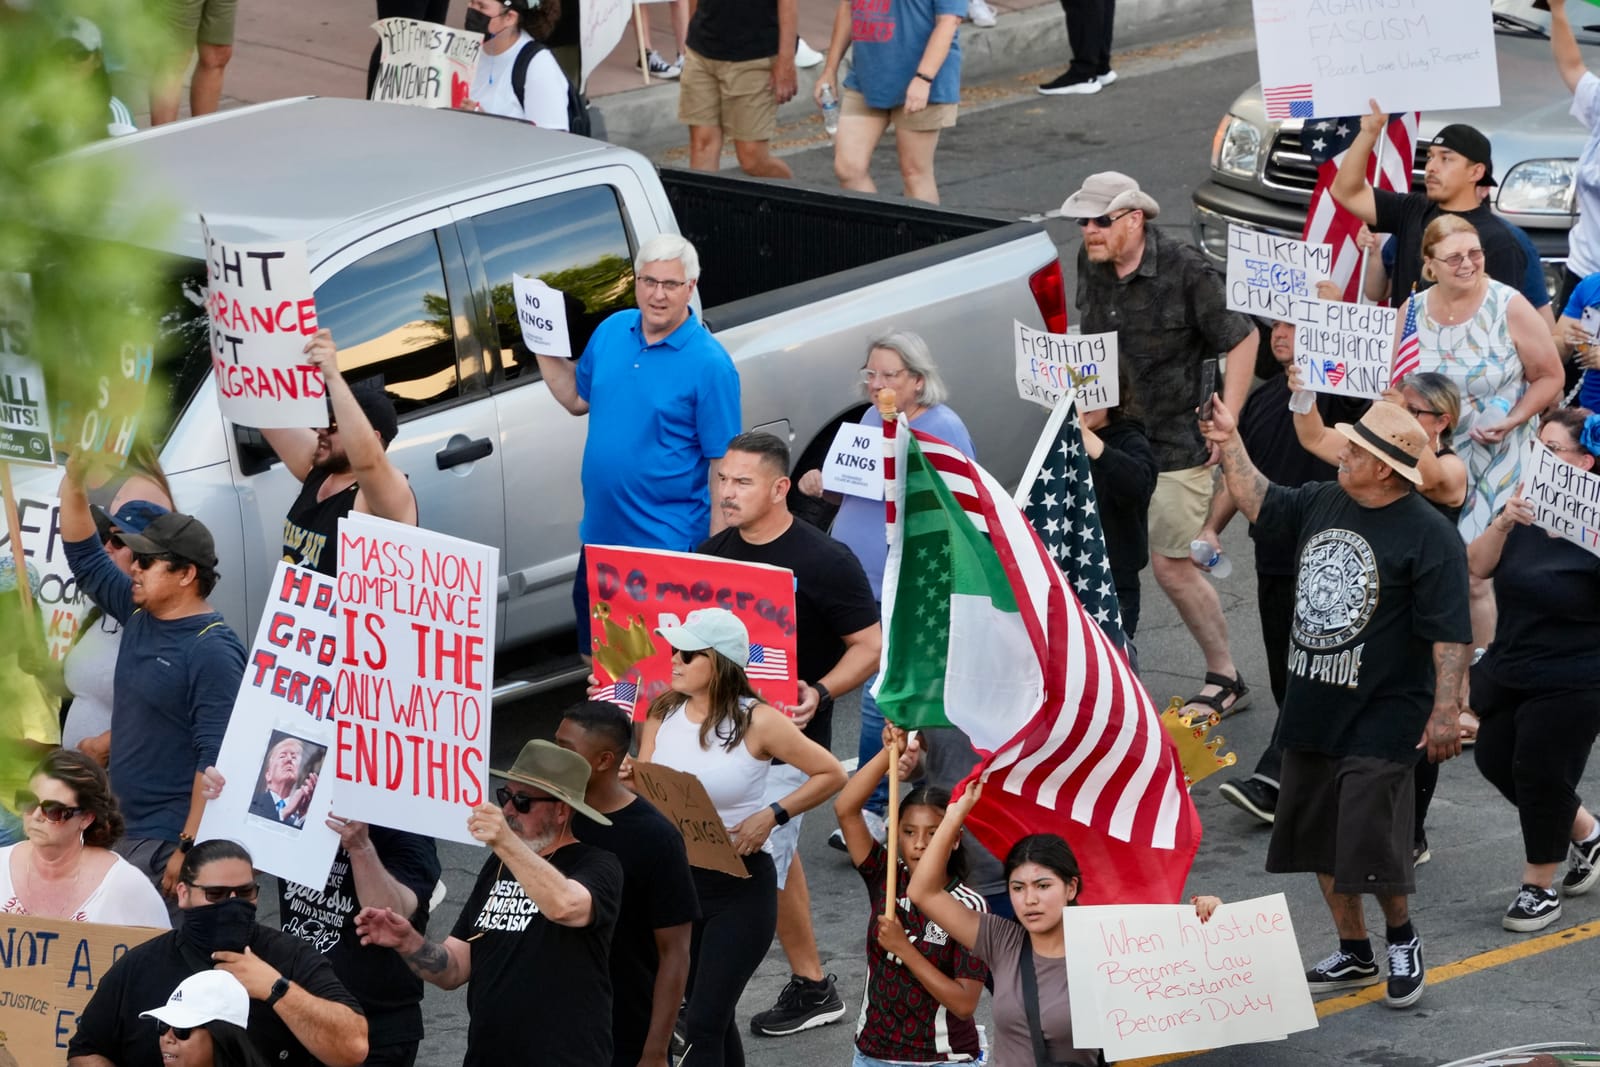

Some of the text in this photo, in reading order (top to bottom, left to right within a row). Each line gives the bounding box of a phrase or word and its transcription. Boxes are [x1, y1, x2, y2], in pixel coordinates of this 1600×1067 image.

[1308, 14, 1431, 48] FASCISM
[1360, 53, 1395, 74] Love
[1230, 229, 1251, 253] I
[205, 236, 285, 291] GHT
[1245, 259, 1308, 297] ICE
[209, 290, 319, 336] RANCE
[525, 293, 540, 309] NO
[1298, 300, 1320, 323] I
[520, 309, 553, 331] KINGS
[212, 331, 244, 364] OT
[1021, 327, 1106, 363] Fighting
[1300, 326, 1388, 364] allegiance
[212, 360, 326, 401] IGRANTS
[1030, 358, 1099, 389] fascim
[1297, 353, 1308, 364] to
[1346, 366, 1389, 393] KING
[1074, 385, 1107, 406] 941
[852, 436, 870, 449] NO
[836, 453, 876, 471] KINGS
[341, 532, 481, 594] MASS NON
[280, 567, 336, 618] HO
[338, 572, 481, 628] COMPLIANCE
[342, 609, 483, 690] IS THE
[1310, 643, 1365, 688] PRIDE
[335, 669, 480, 741] ONLY WAY TO
[336, 721, 482, 807] END THIS
[319, 908, 345, 928] CACTUS
[1100, 912, 1286, 957] When Injustice
[0, 928, 59, 968] NOT
[67, 939, 93, 990] A
[1097, 951, 1252, 985] Becomes Law
[1, 991, 50, 1015] JUSTICE
[1134, 970, 1254, 1000] Resistance
[1107, 994, 1273, 1041] Becomes Duty
